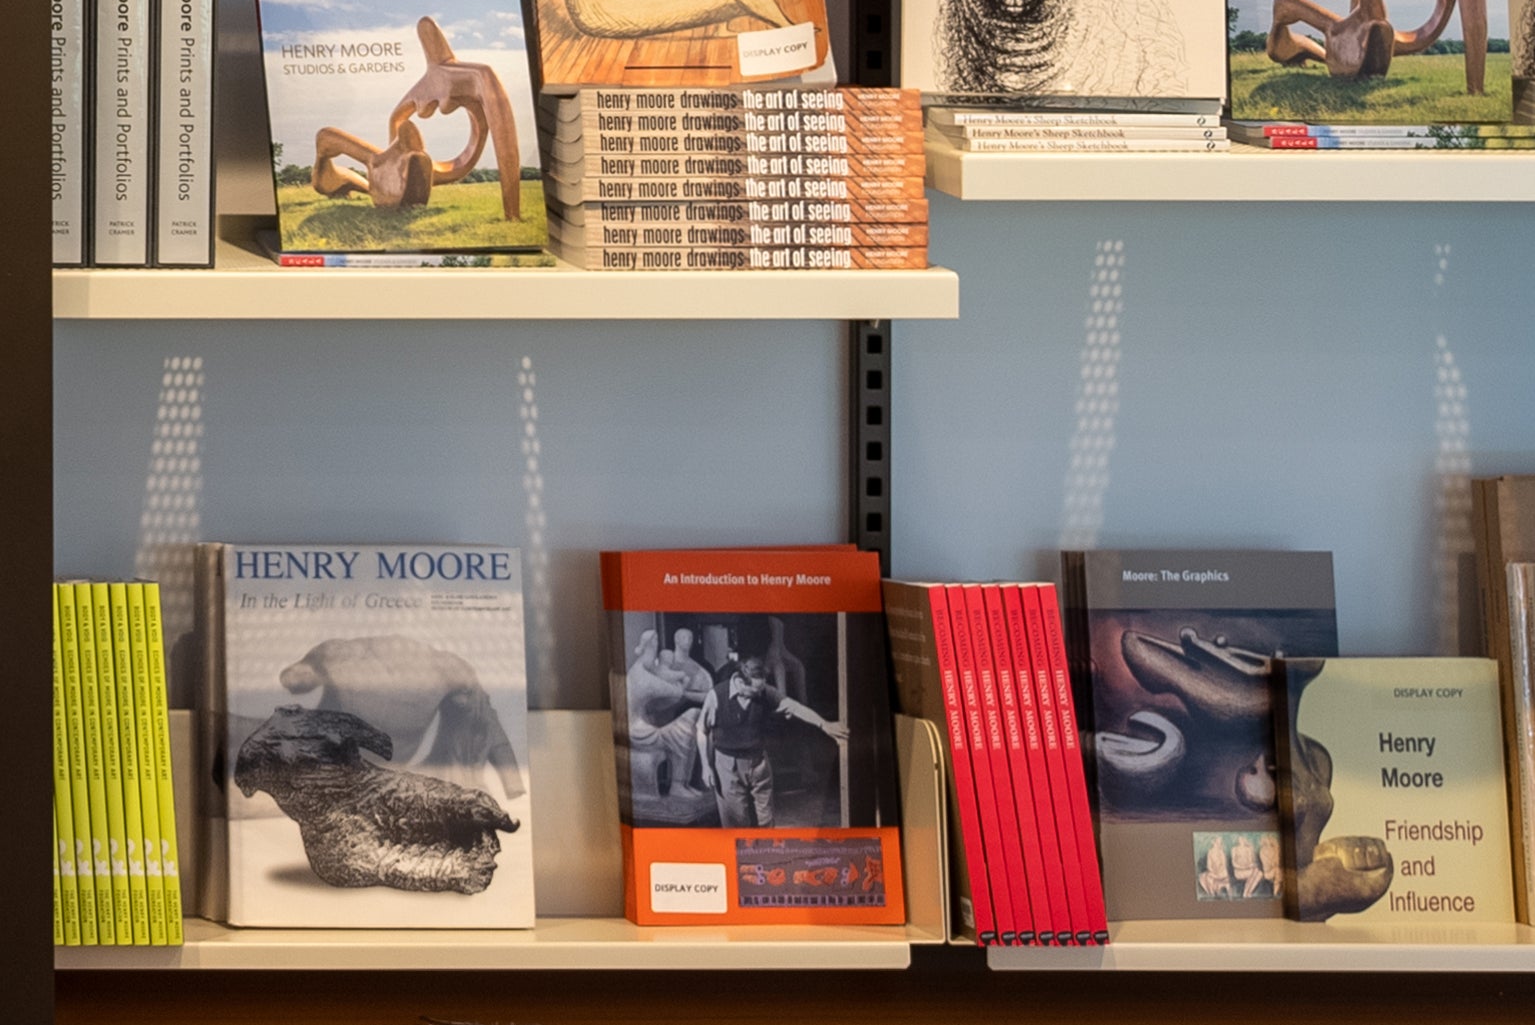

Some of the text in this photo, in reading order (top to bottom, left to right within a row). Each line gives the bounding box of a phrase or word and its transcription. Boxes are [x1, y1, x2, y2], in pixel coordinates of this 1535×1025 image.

[784, 42, 808, 54] COPY
[180, 38, 195, 83] Prints
[179, 88, 195, 118] and
[178, 124, 195, 201] Portfolios
[235, 552, 512, 580] HENRY MOORE
[664, 573, 831, 588] An Introduction to Henry Moore
[1122, 570, 1229, 584] Moore: The Graphics
[240, 593, 256, 609] In
[264, 593, 288, 609] the
[294, 593, 335, 610] Light
[342, 592, 360, 609] of
[365, 593, 422, 609] Greece
[1394, 688, 1463, 698] DISPLAY COPY
[1056, 670, 1069, 706] HENRY
[1063, 710, 1075, 749] MOORE
[1379, 733, 1436, 757] Henry
[1381, 768, 1443, 787] Moore
[1385, 820, 1483, 846] Friendship
[1401, 856, 1435, 876] and
[654, 884, 718, 893] DISPLAY COPY
[1389, 891, 1475, 912] Influence
